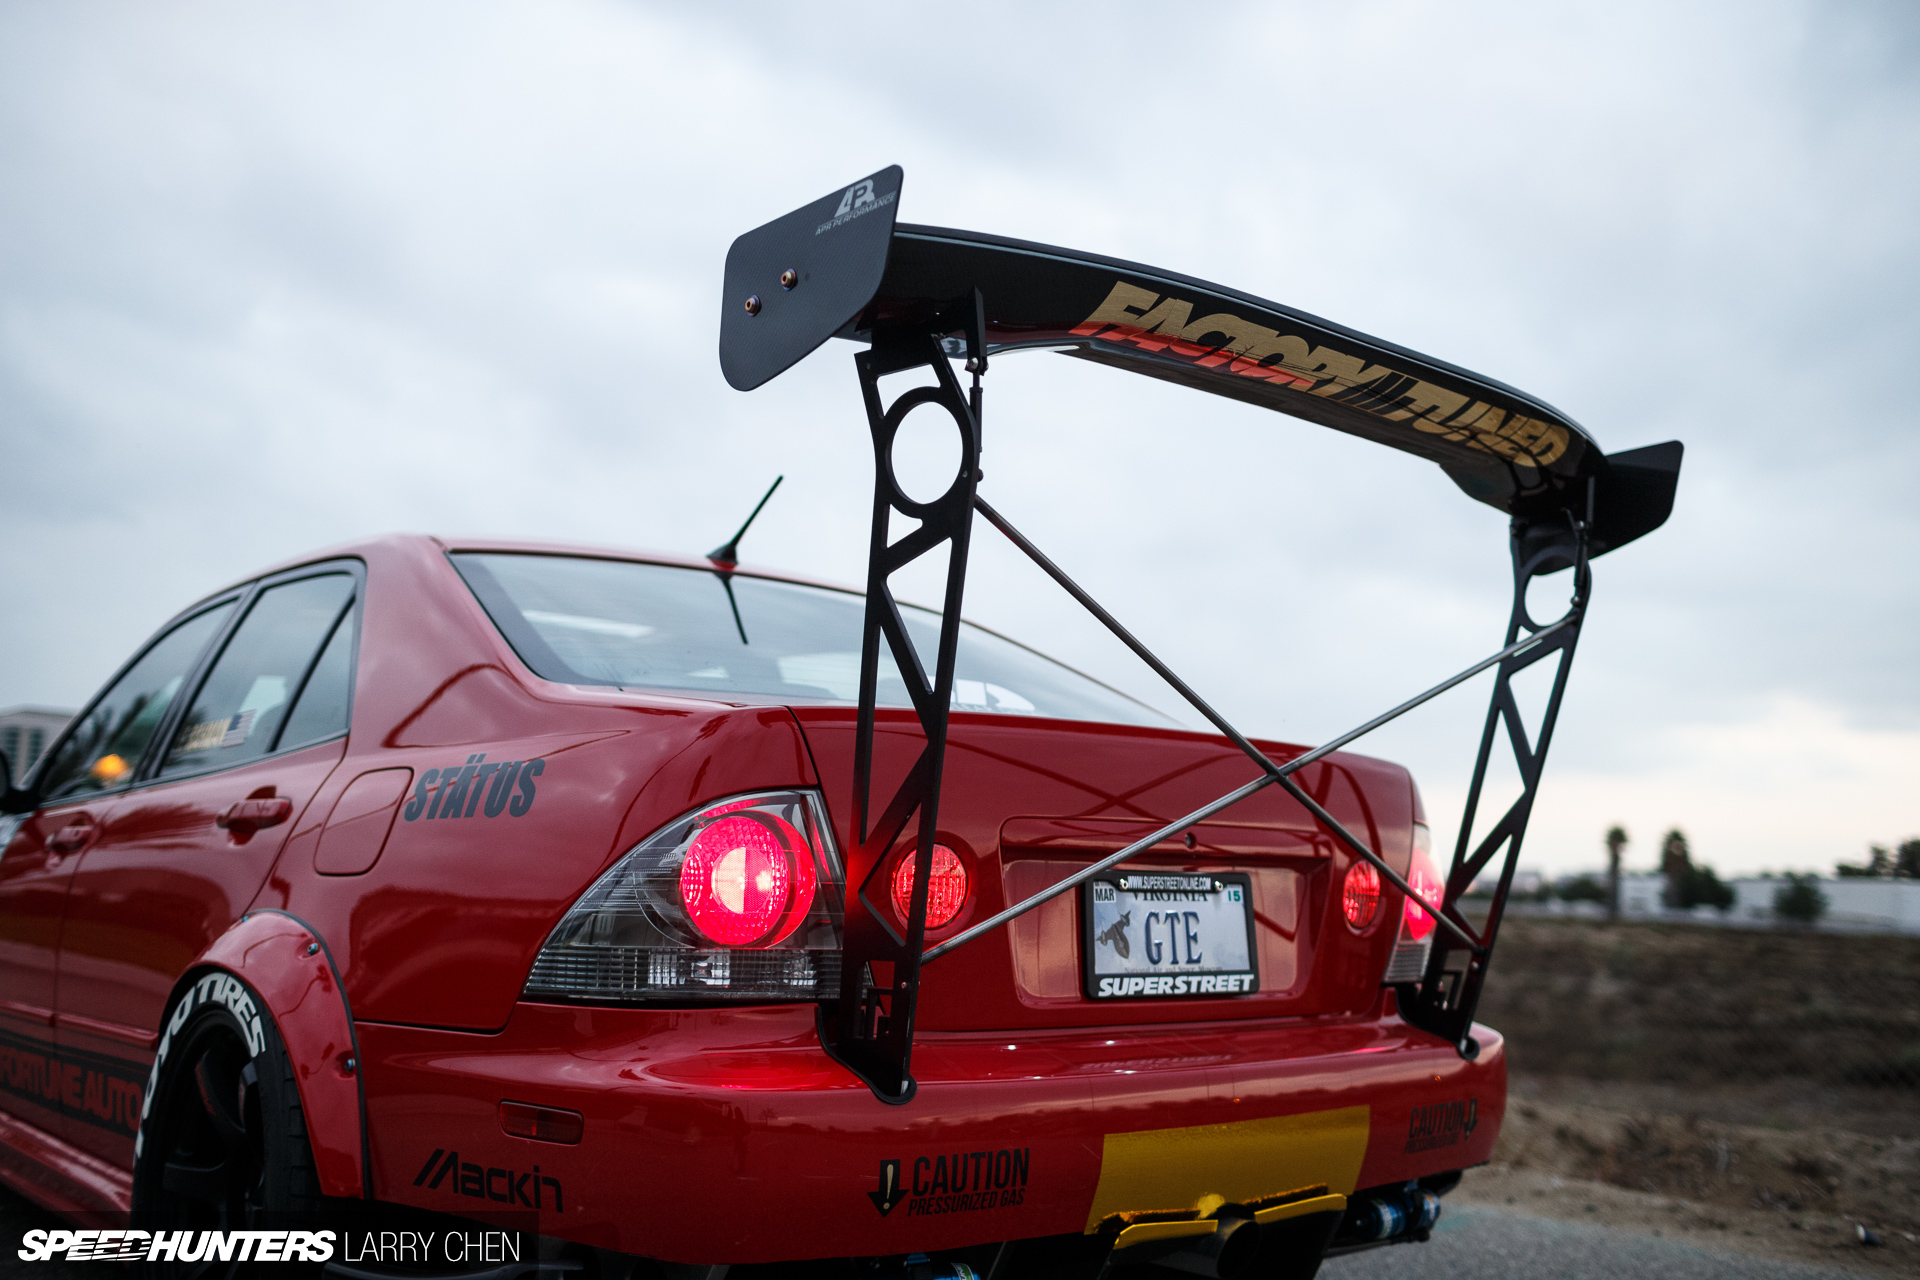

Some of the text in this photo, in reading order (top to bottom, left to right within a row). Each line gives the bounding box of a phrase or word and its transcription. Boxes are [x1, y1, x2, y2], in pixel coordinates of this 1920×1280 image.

[815, 192, 896, 236] APR PERFORMANCE
[403, 753, 546, 822] STÄTUS
[1095, 888, 1115, 901] MAR
[1128, 875, 1211, 890] WWW.SUPERSTREETONLINE.COM
[1228, 890, 1241, 902] 15
[1145, 910, 1202, 965] GTE
[1098, 974, 1254, 997] SUPERSTREET
[196, 972, 266, 1058] TIRES
[82, 1069, 143, 1132] AUTO
[1408, 1099, 1466, 1139] CAUTION
[412, 1148, 563, 1213] Mackin
[912, 1148, 1030, 1197] CAUTION
[908, 1188, 1026, 1217] PRESSURIZED GAS
